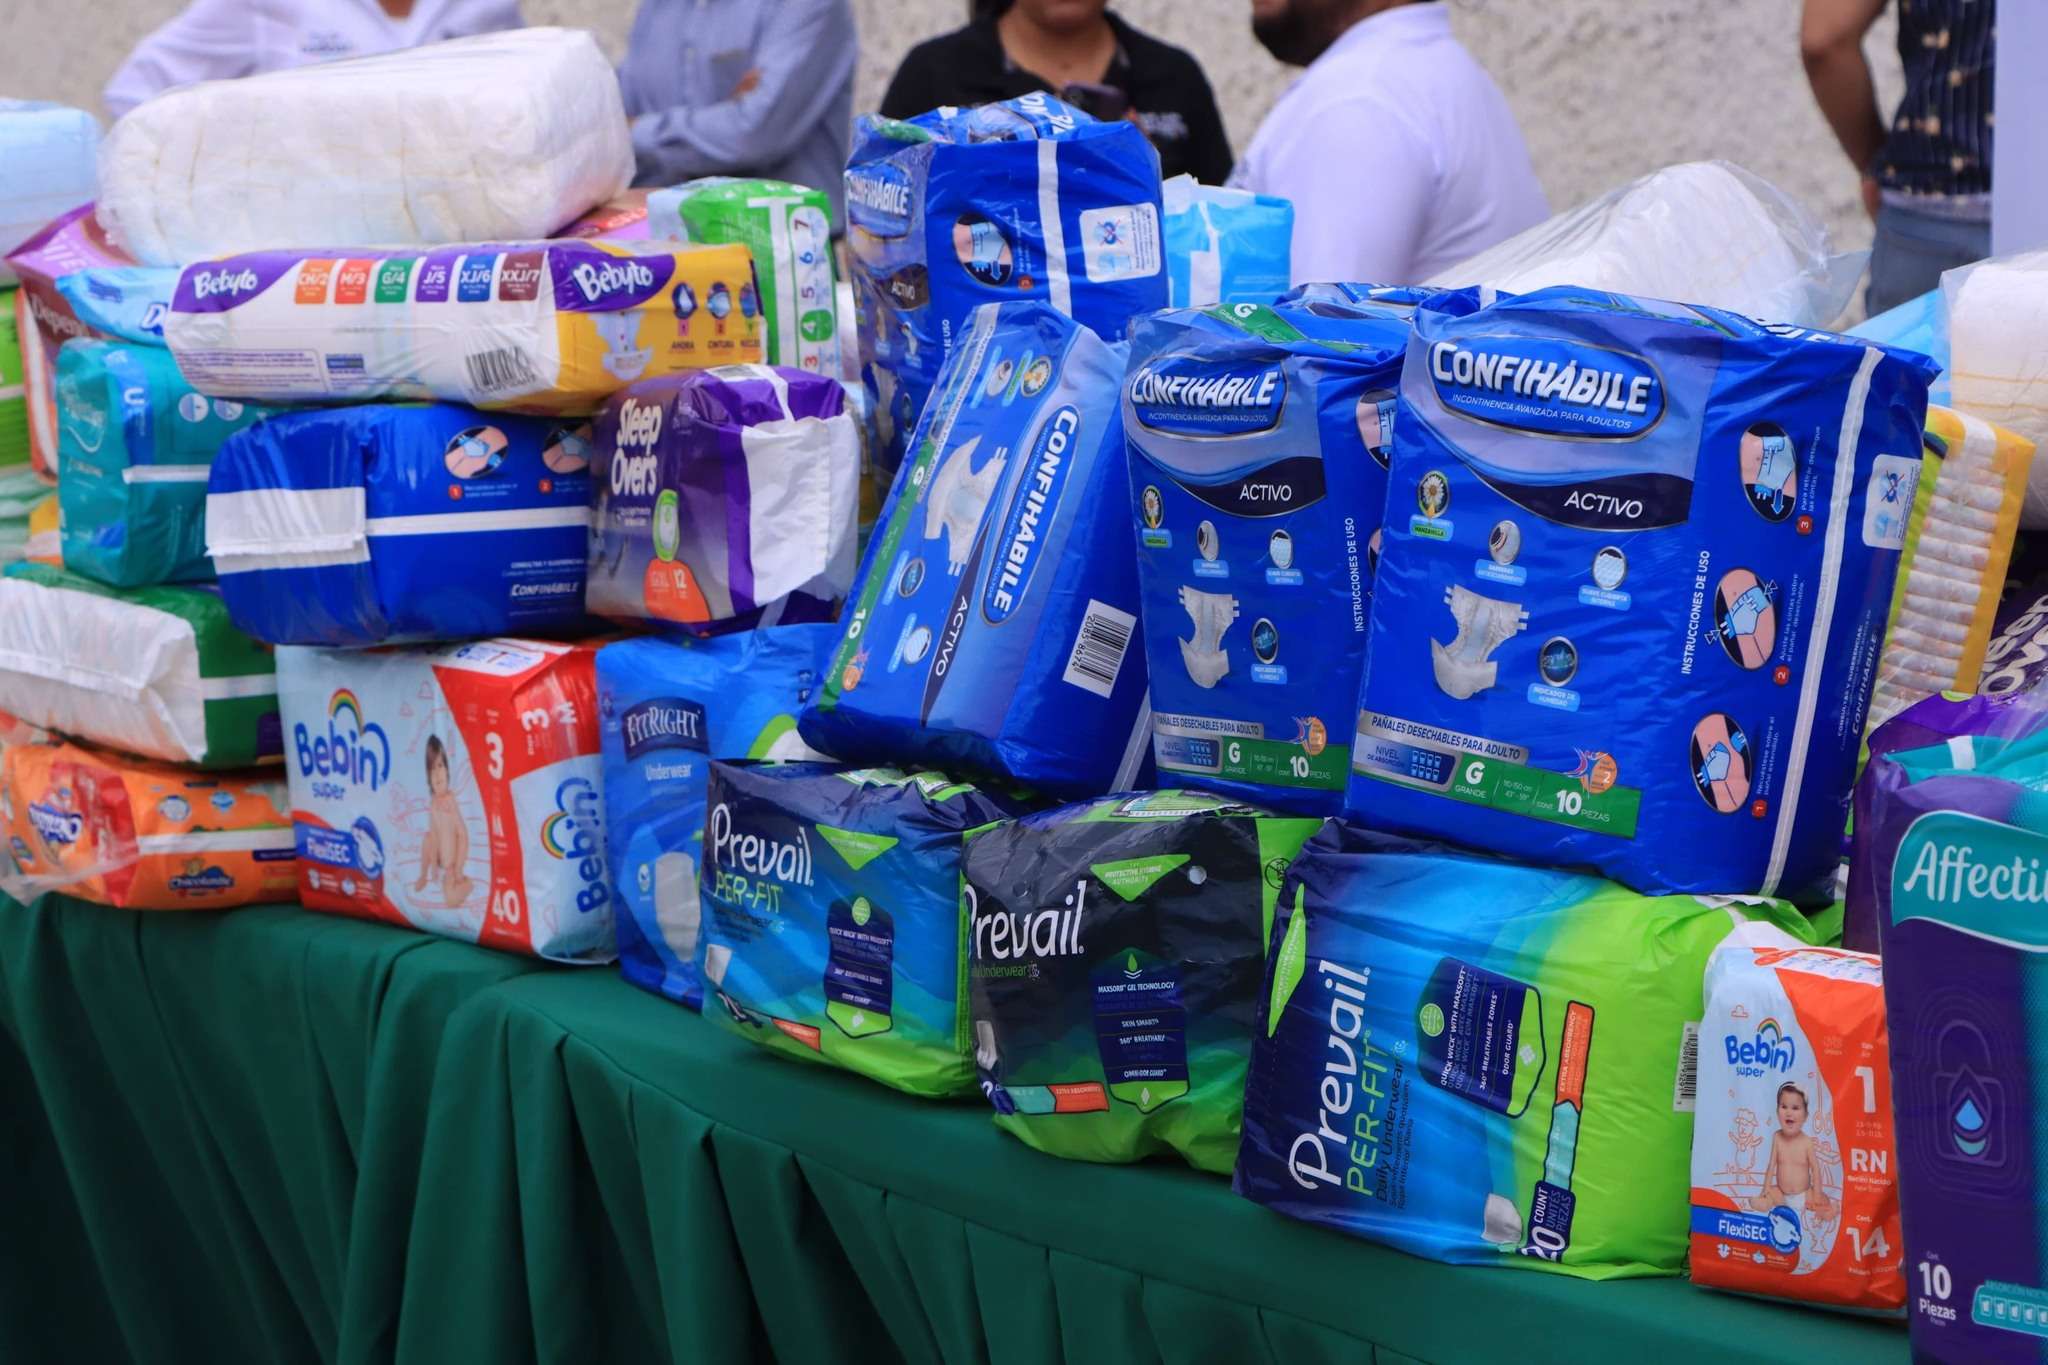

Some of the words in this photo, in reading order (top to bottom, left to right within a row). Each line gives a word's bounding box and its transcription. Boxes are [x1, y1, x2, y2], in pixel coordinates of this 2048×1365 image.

[794, 218, 810, 231] 7
[799, 251, 814, 264] 6
[573, 261, 654, 302] Bebyto
[801, 286, 816, 299] 5
[1130, 367, 1279, 407] CONFIHÁBILE
[1432, 341, 1651, 414] CONFIHÁBILE
[616, 398, 663, 457] Sleep
[1452, 393, 1514, 411] INCONTINENCIA
[1514, 402, 1559, 418] AVANZADA
[1560, 409, 1585, 423] PARA
[1585, 413, 1633, 430] ADULTOS
[611, 448, 658, 496] Overs
[993, 409, 1078, 613] CONFIHÁBILE
[1239, 484, 1293, 502] ACTIVO
[1563, 490, 1644, 519] ACTIVO
[1344, 517, 1354, 539] USO
[1346, 539, 1357, 554] DE
[1698, 550, 1711, 573] USO
[1348, 554, 1365, 633] INSTRUCCIONES
[1695, 573, 1707, 588] DE
[848, 608, 866, 640] 10
[935, 595, 969, 677] ACTIVO
[1681, 588, 1706, 676] INSTRUCCIONES
[521, 707, 549, 732] 3
[1219, 721, 1236, 733] PARA
[1371, 714, 1406, 733] PAÑALES
[1406, 724, 1462, 747] DESECHABLES
[1461, 737, 1484, 752] PARA
[1484, 743, 1521, 760] ADULTO
[294, 717, 391, 792] Bebin
[485, 731, 505, 780] 3
[1228, 742, 1241, 764] G
[1289, 756, 1310, 779] 10
[1455, 784, 1487, 799] GRANDE
[1465, 761, 1486, 785] G
[1556, 789, 1583, 816] 10
[711, 803, 814, 887] Prevail
[1903, 840, 2048, 904] Affecti
[493, 889, 520, 925] 40
[713, 869, 783, 914] PER-FIT
[1137, 981, 1175, 991] TECHNOLOGY
[1452, 966, 1467, 1010] MAXSOFT
[1450, 1010, 1459, 1033] WITH
[1482, 1022, 1494, 1072] BREATHABLE
[1488, 991, 1499, 1021] ZONES
[1447, 1036, 1456, 1060] WICK
[1502, 1051, 1512, 1076] ODOR
[1507, 1020, 1515, 1052] GUARD
[1725, 1034, 1796, 1073] Bebin
[1288, 959, 1371, 1190] Prevail
[1440, 1060, 1454, 1086] QUICK
[1736, 1066, 1766, 1080] super
[1855, 1065, 1877, 1114] 1
[1346, 1034, 1389, 1197] PER-FIT
[1382, 1061, 1406, 1156] Underwear
[1375, 1157, 1392, 1203] Daily
[1850, 1148, 1888, 1175] RN
[1534, 1187, 1550, 1224] COUNT
[1556, 1194, 1572, 1232] PIEZAS
[1718, 1218, 1767, 1241] FlexiSEC
[1846, 1226, 1890, 1263] 14
[1918, 1261, 1952, 1300] 10
[1919, 1297, 1957, 1321] Piezas
